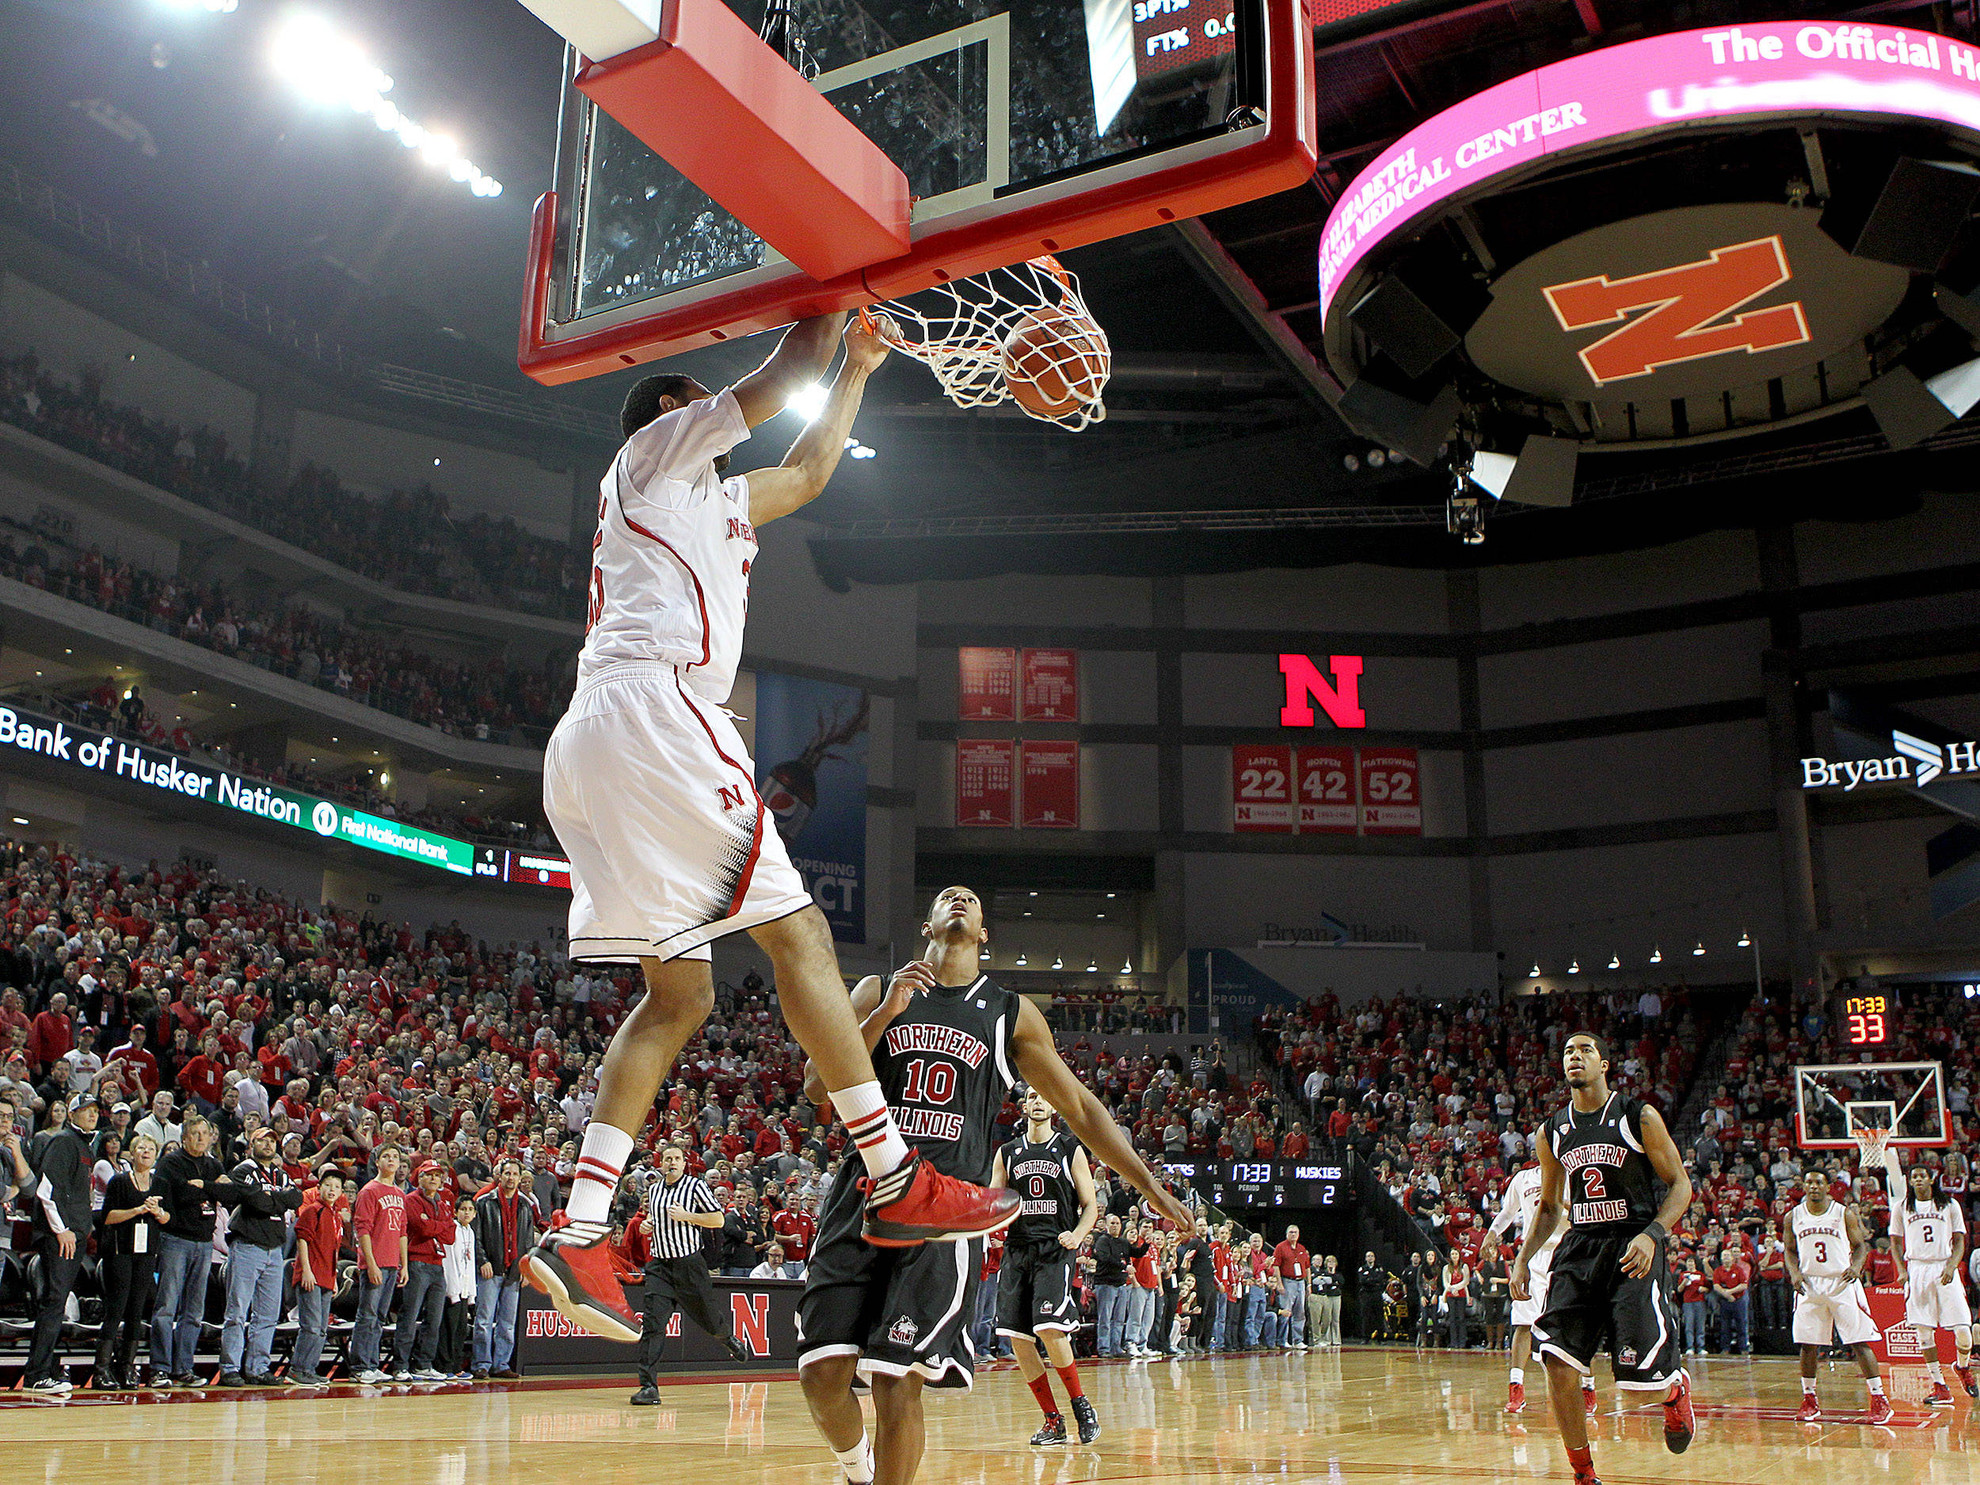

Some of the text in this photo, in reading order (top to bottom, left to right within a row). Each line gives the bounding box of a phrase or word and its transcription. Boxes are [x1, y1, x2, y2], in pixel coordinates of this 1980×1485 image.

[1146, 26, 1190, 57] FT%
[1702, 26, 1980, 81] The Official H
[1355, 101, 1588, 242] MEDICAL CENTER
[1541, 234, 1812, 387] N
[1279, 653, 1366, 728] N
[1248, 756, 1279, 767] LANTZ
[1800, 741, 1980, 792] Bryan H
[0, 706, 73, 761] Bank
[78, 736, 114, 770] of
[116, 743, 213, 799] Husker
[217, 772, 301, 825] Nation
[341, 815, 367, 836] First
[366, 823, 418, 852] National
[418, 838, 449, 862] Bank
[714, 783, 746, 812] N
[1240, 769, 1286, 798] 22
[1302, 770, 1348, 799] 42
[1368, 771, 1413, 800] 52
[1237, 807, 1251, 820] N
[1301, 808, 1315, 821] N
[1365, 810, 1380, 822] N
[792, 856, 857, 878] OPENING
[1264, 922, 1329, 946] Bryan
[1846, 995, 1887, 1014] 17:33
[1848, 1013, 1885, 1044] 33
[885, 1023, 989, 1070] NORTHERN
[902, 1058, 958, 1106] 10
[1013, 1159, 1062, 1180] NORTHERN
[1231, 1163, 1272, 1183] 17:33
[1295, 1166, 1342, 1180] HUSKIES
[1560, 1143, 1628, 1175] NORTHERN
[1029, 1175, 1045, 1198] 0
[1237, 1184, 1260, 1192] PERIOD
[1322, 1184, 1336, 1205] 2
[1582, 1166, 1607, 1199] 2
[1573, 1198, 1629, 1225] ILLINOIS
[1922, 1225, 1934, 1243] 2
[1814, 1241, 1828, 1264] 3
[730, 1293, 771, 1357] N
